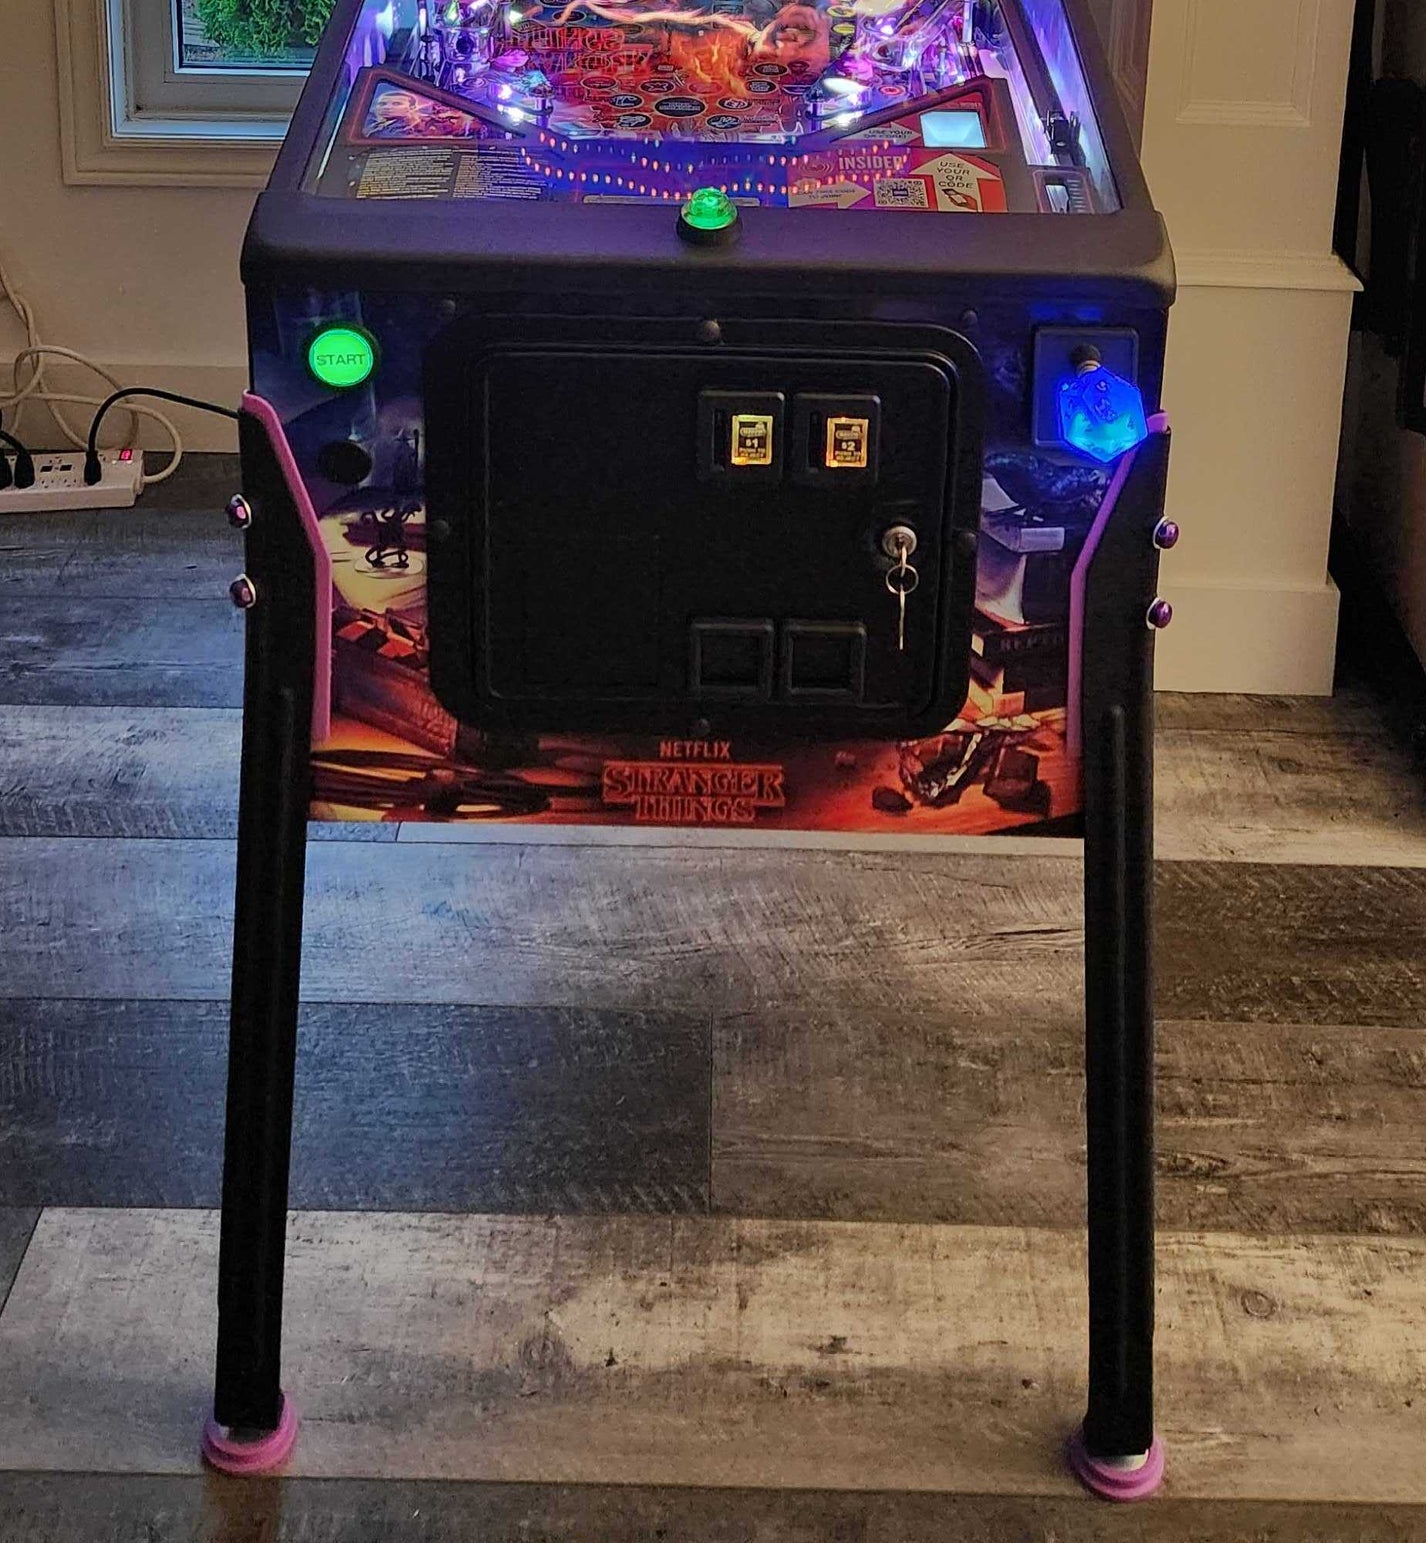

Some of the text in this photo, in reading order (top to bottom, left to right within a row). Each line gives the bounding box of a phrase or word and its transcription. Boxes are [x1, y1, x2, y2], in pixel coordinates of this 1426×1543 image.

[839, 156, 902, 170] INSIDER
[937, 167, 970, 175] YOUR
[938, 180, 973, 188] CODE
[316, 354, 366, 366] START
[659, 741, 731, 758] NETFLIX
[603, 766, 785, 801] STRANGER
[636, 796, 756, 822] THINGS
